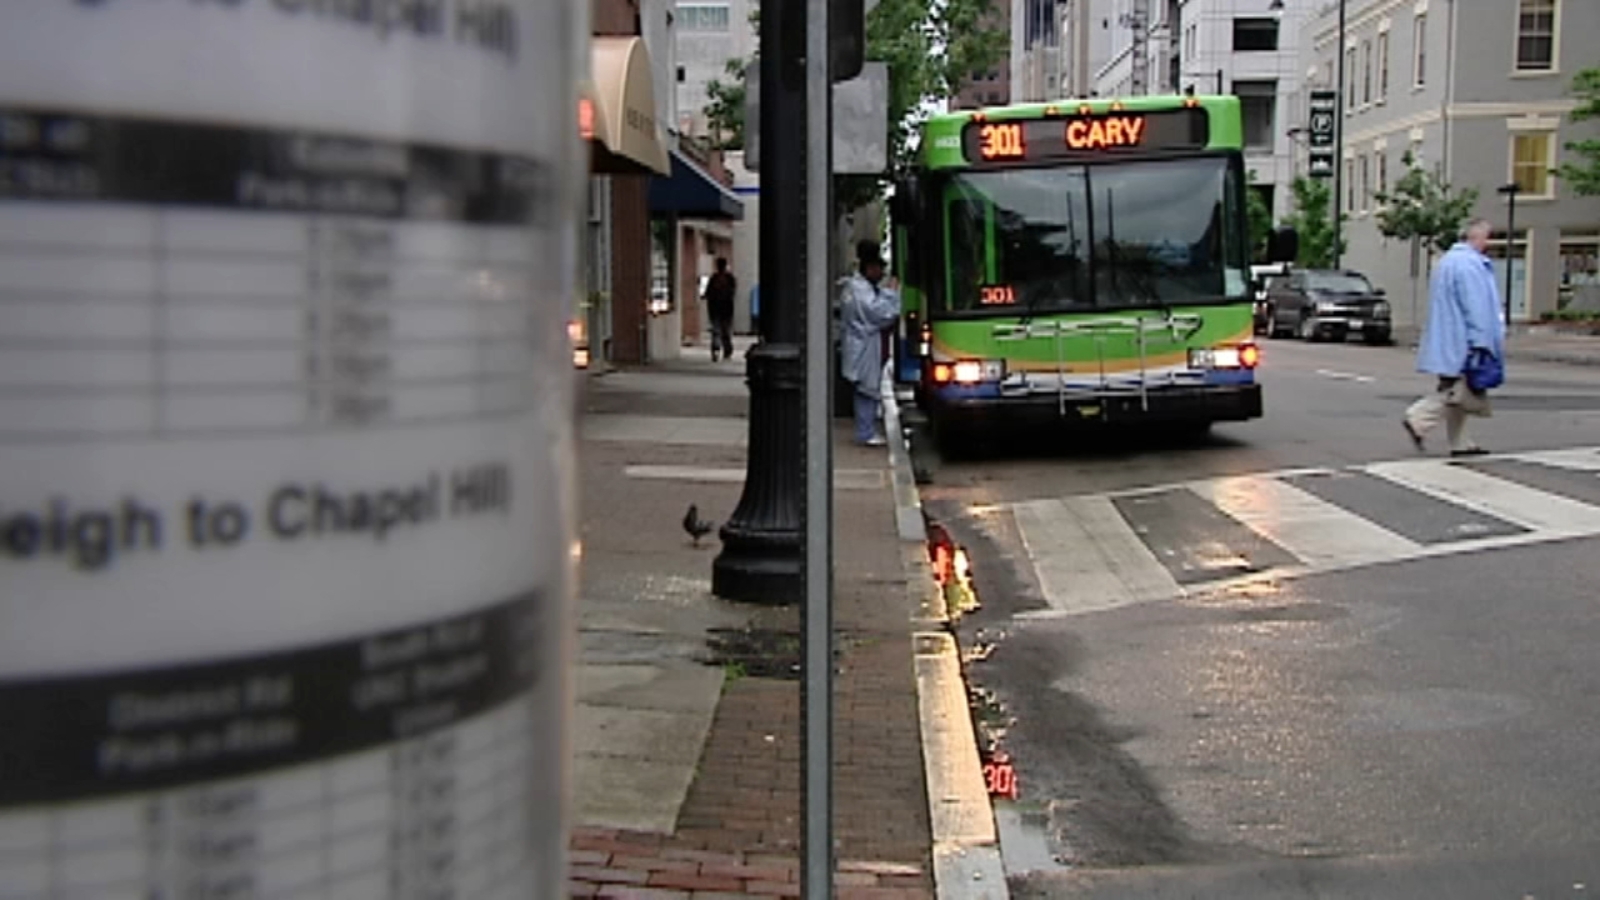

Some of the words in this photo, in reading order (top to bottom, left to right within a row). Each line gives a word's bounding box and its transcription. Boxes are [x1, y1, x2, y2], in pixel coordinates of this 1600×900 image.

[981, 124, 1024, 157] 301
[1066, 117, 1143, 149] CARY
[981, 286, 1016, 304] 301
[187, 494, 252, 550] to
[266, 473, 441, 542] Chapel
